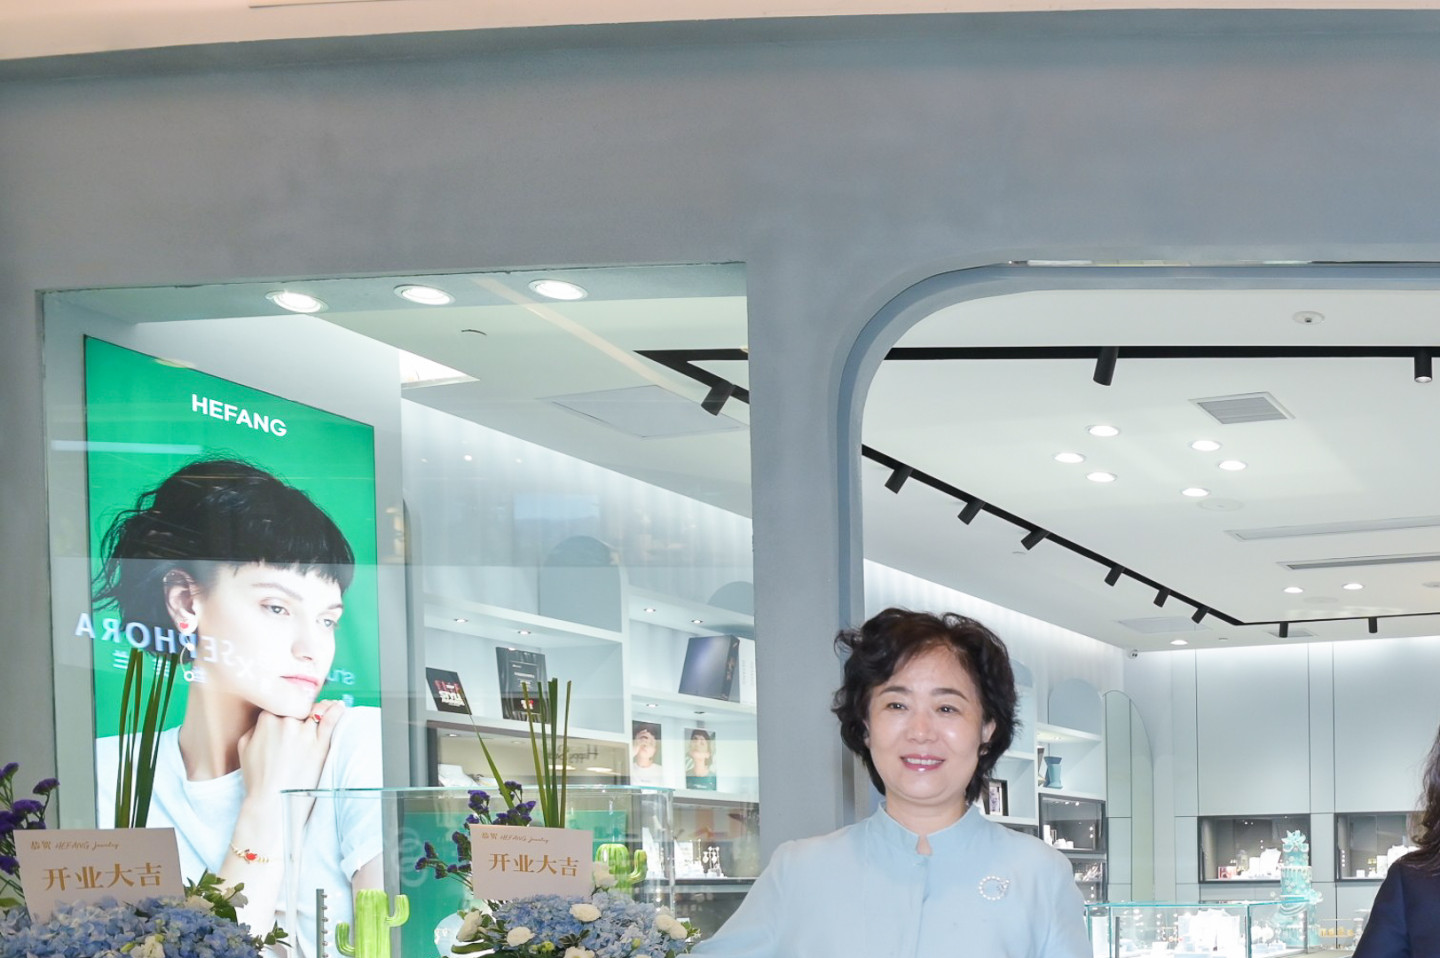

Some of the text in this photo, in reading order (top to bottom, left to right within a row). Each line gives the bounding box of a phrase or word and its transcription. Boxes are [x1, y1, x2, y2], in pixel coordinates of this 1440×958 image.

[191, 393, 288, 437] HEFANG
[42, 862, 163, 892] 开业大吉
[488, 852, 580, 877] 开业大吉
